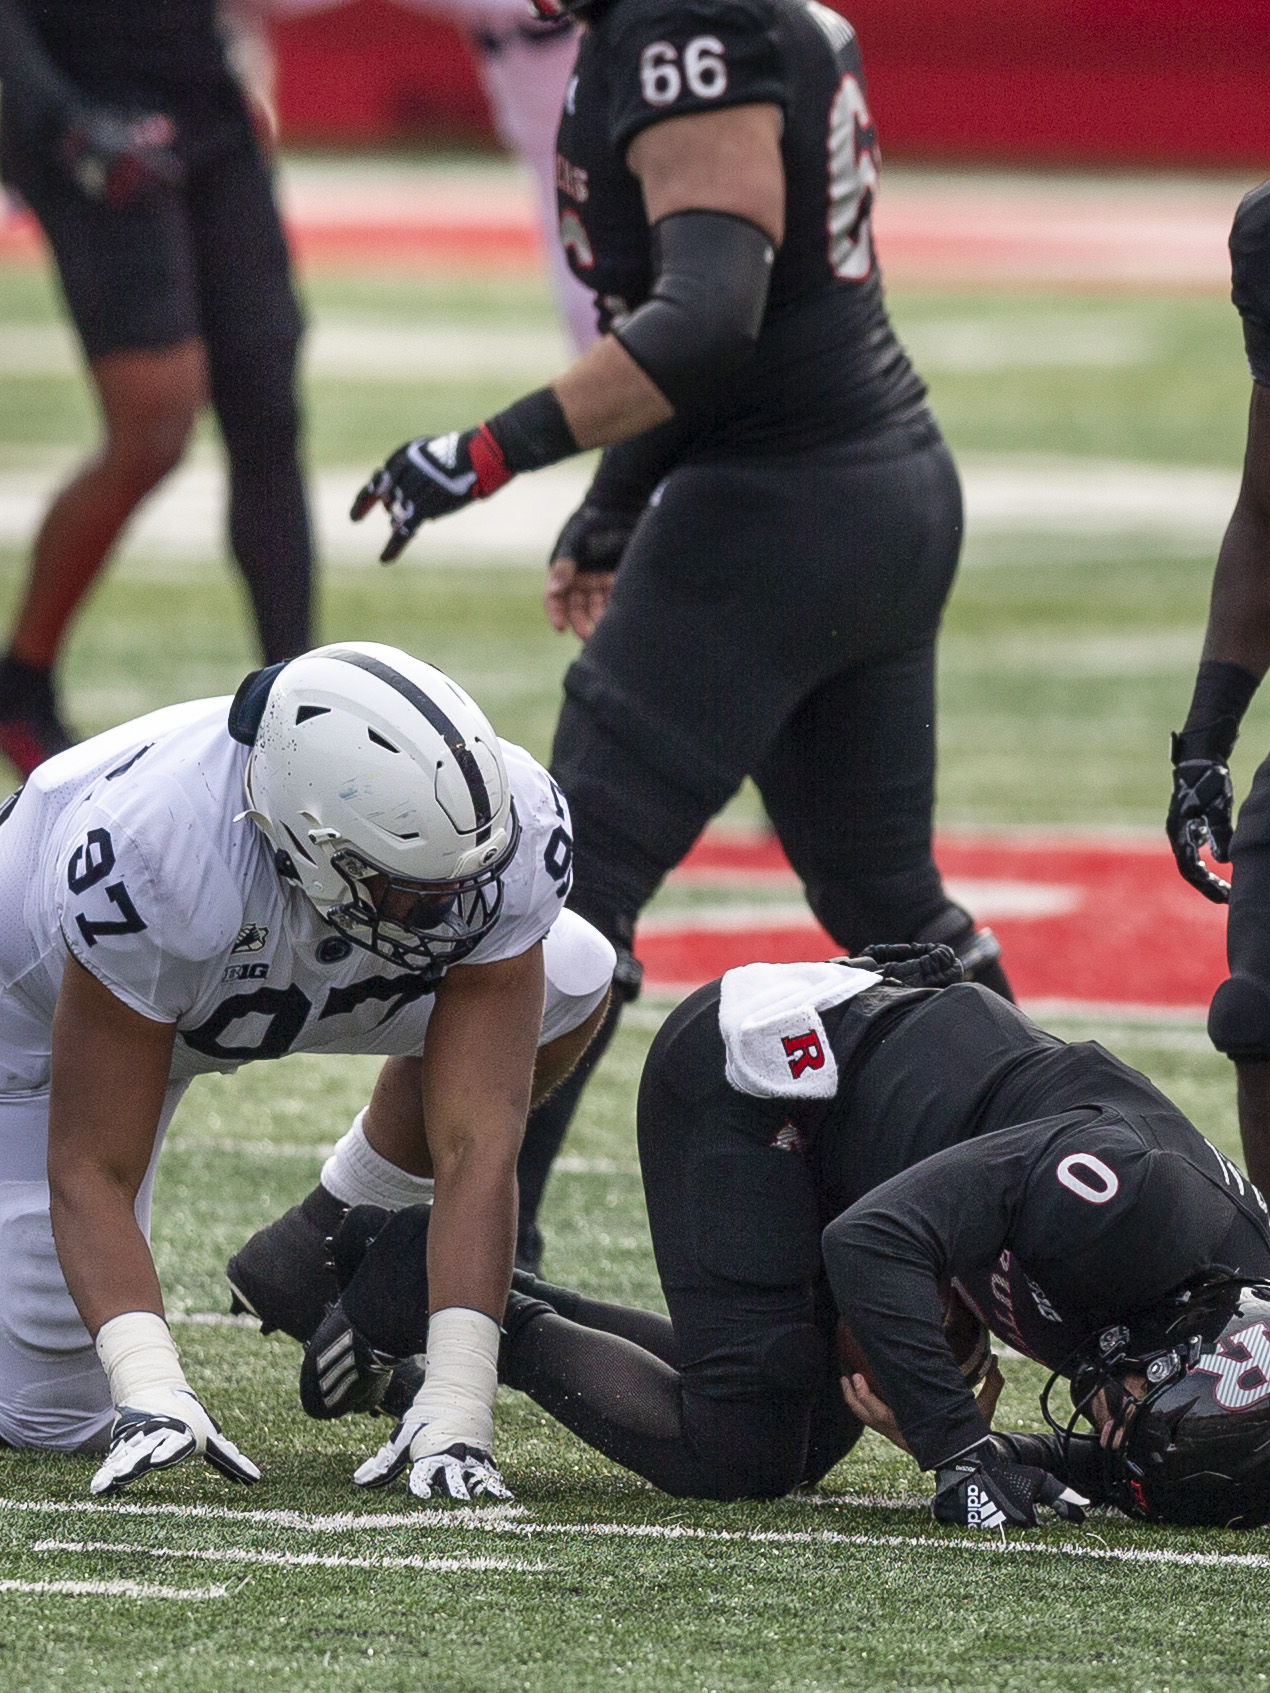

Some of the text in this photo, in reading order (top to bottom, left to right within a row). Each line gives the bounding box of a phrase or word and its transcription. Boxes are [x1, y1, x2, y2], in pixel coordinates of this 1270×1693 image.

[641, 35, 728, 106] 66
[68, 827, 149, 948] 97
[781, 1028, 826, 1080] R
